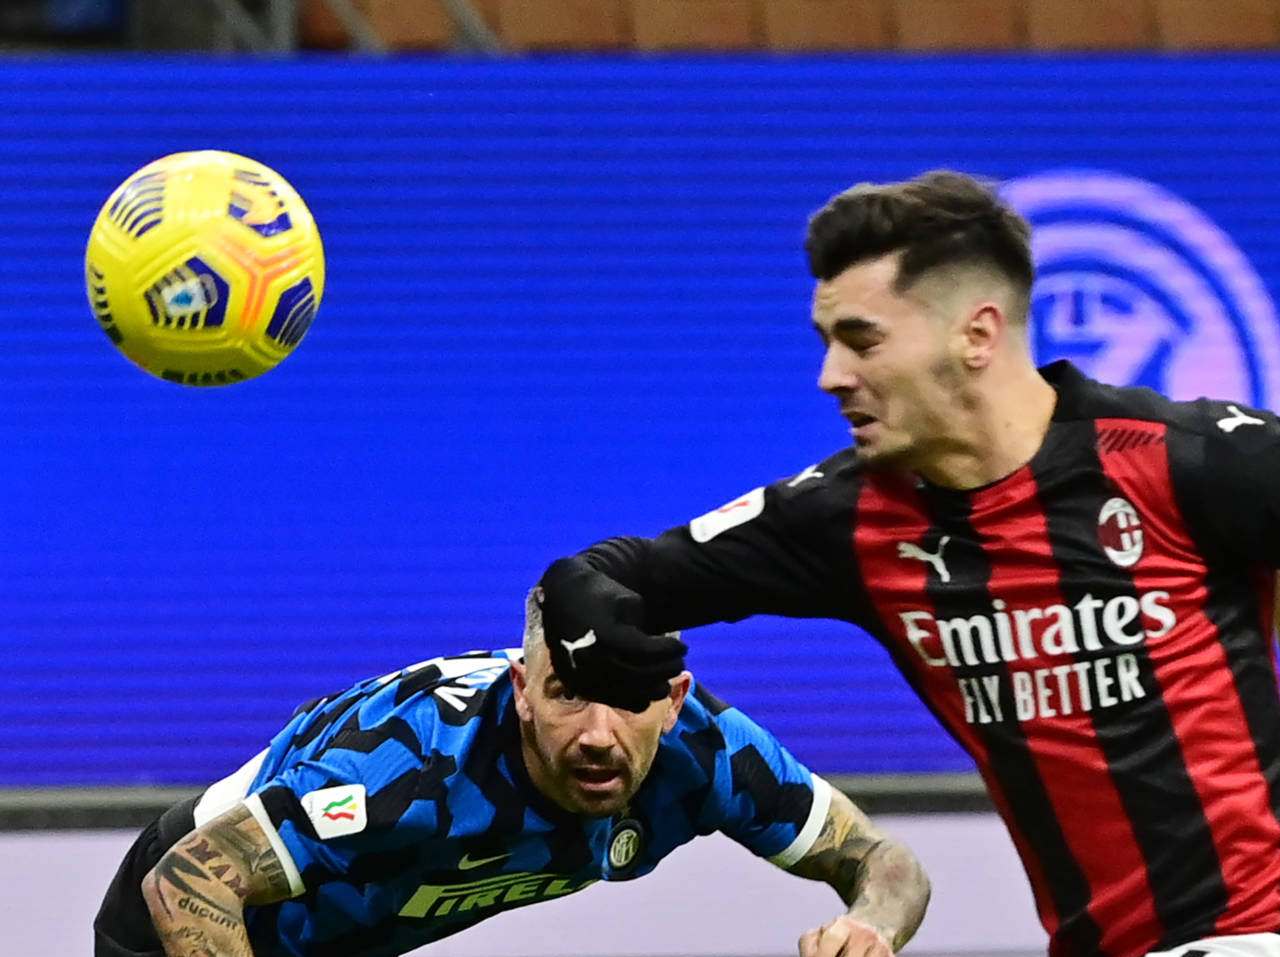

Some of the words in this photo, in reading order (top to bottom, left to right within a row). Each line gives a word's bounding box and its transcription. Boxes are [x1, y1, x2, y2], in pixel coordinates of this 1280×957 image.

[899, 590, 1177, 667] Emirates
[958, 674, 1004, 725] FLY
[1012, 653, 1146, 722] BETTER
[398, 872, 600, 918] PIREL
